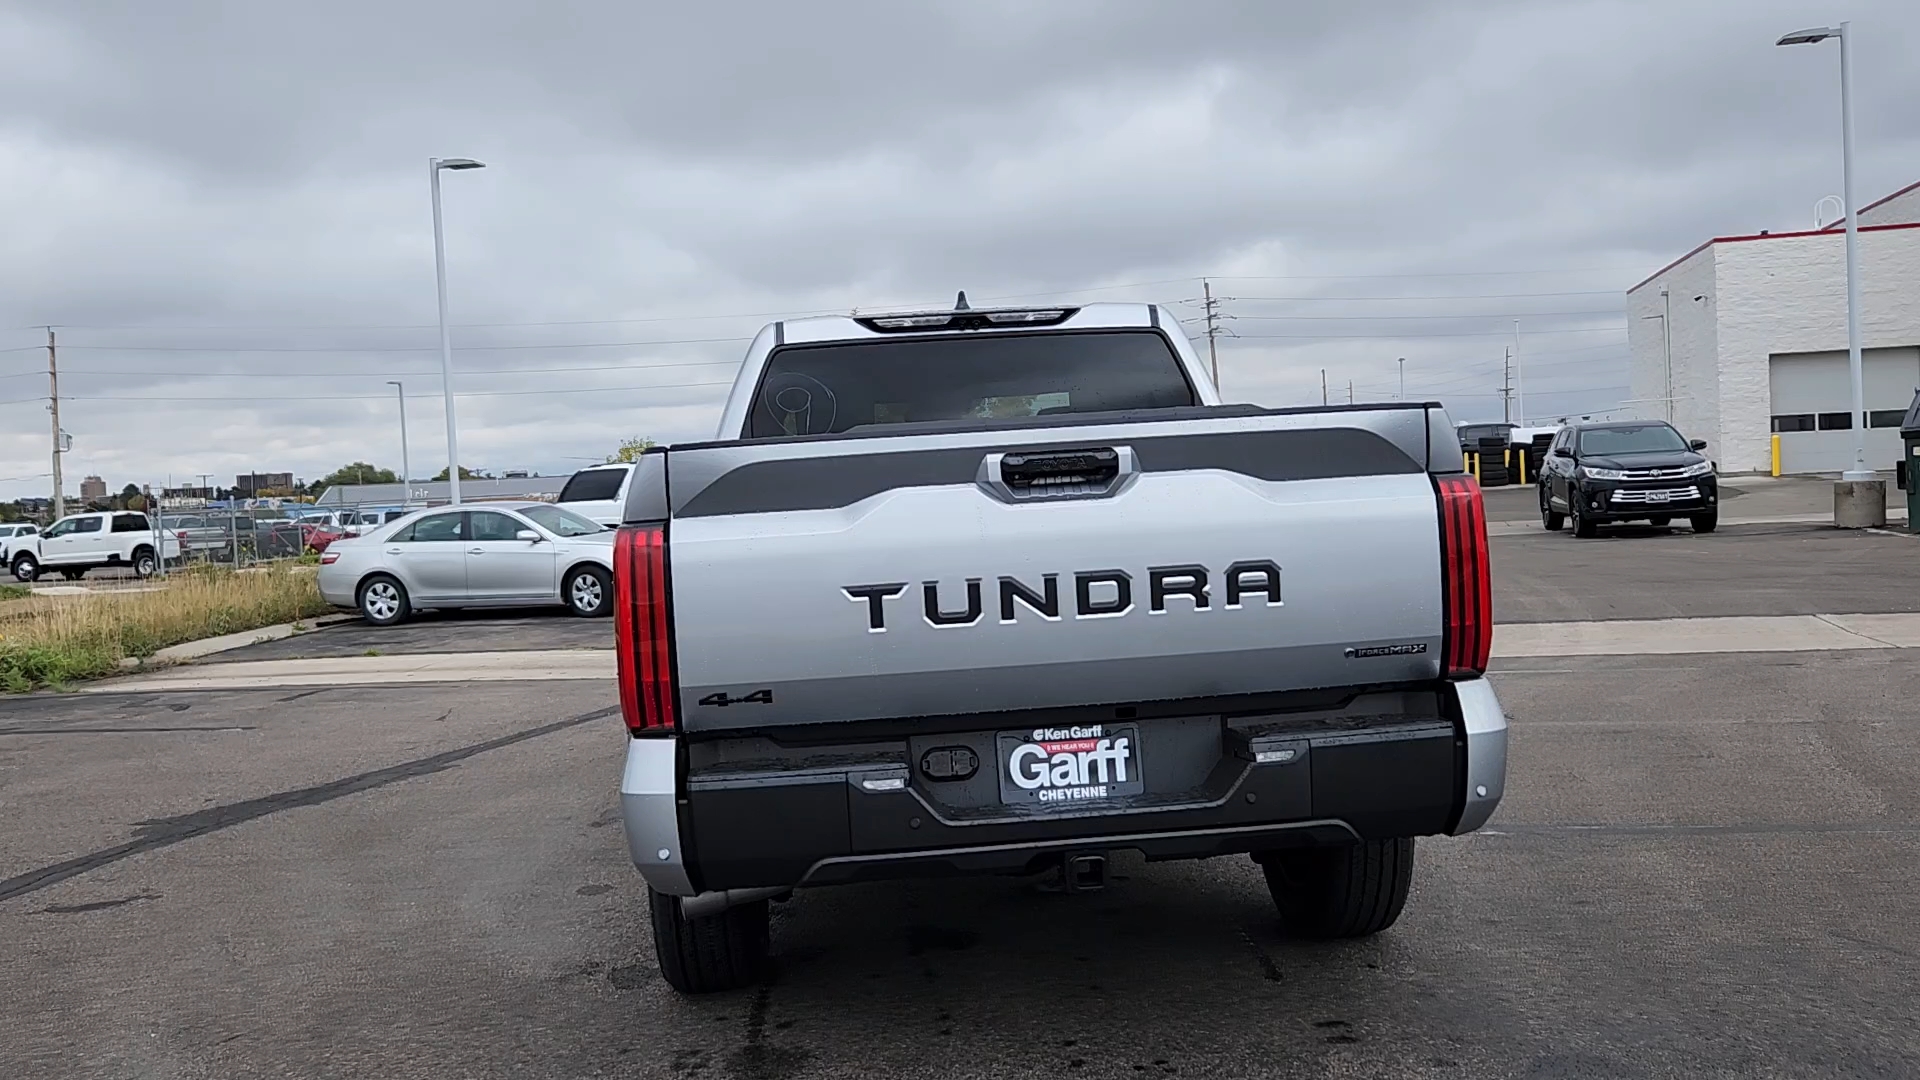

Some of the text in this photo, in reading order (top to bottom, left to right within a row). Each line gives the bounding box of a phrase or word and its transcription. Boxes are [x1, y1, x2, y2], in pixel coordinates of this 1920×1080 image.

[840, 558, 1285, 633] TUNDRA
[1390, 644, 1426, 654] MAX
[1044, 727, 1070, 741] Ken
[1070, 724, 1102, 739] Garff
[1061, 742, 1078, 750] HEAR
[1078, 741, 1091, 749] YOU
[1009, 737, 1130, 789] Garff
[1039, 785, 1108, 801] CHEYENNE
